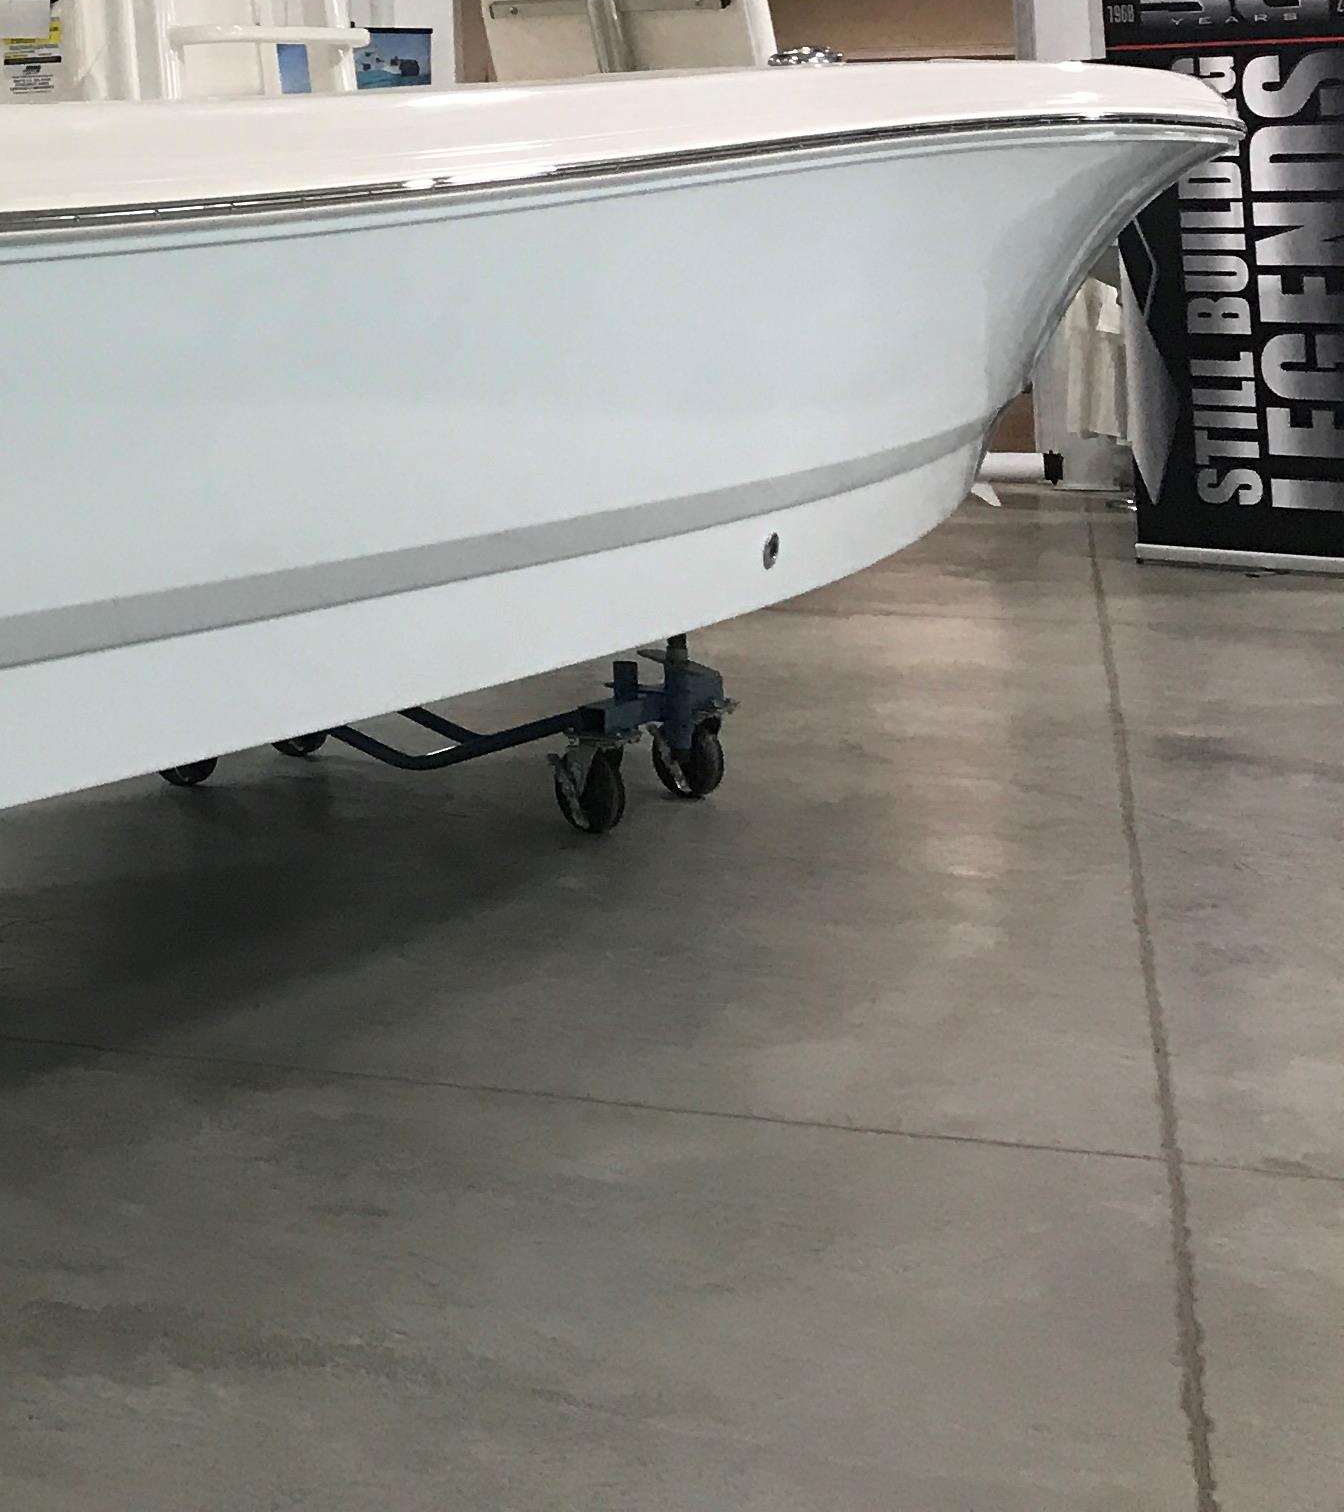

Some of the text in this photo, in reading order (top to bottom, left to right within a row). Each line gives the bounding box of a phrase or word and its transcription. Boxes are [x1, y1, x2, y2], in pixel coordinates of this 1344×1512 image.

[1106, 4, 1136, 24] 1968
[1171, 12, 1298, 26] YEARS
[1171, 55, 1264, 506] STILL BUILDG
